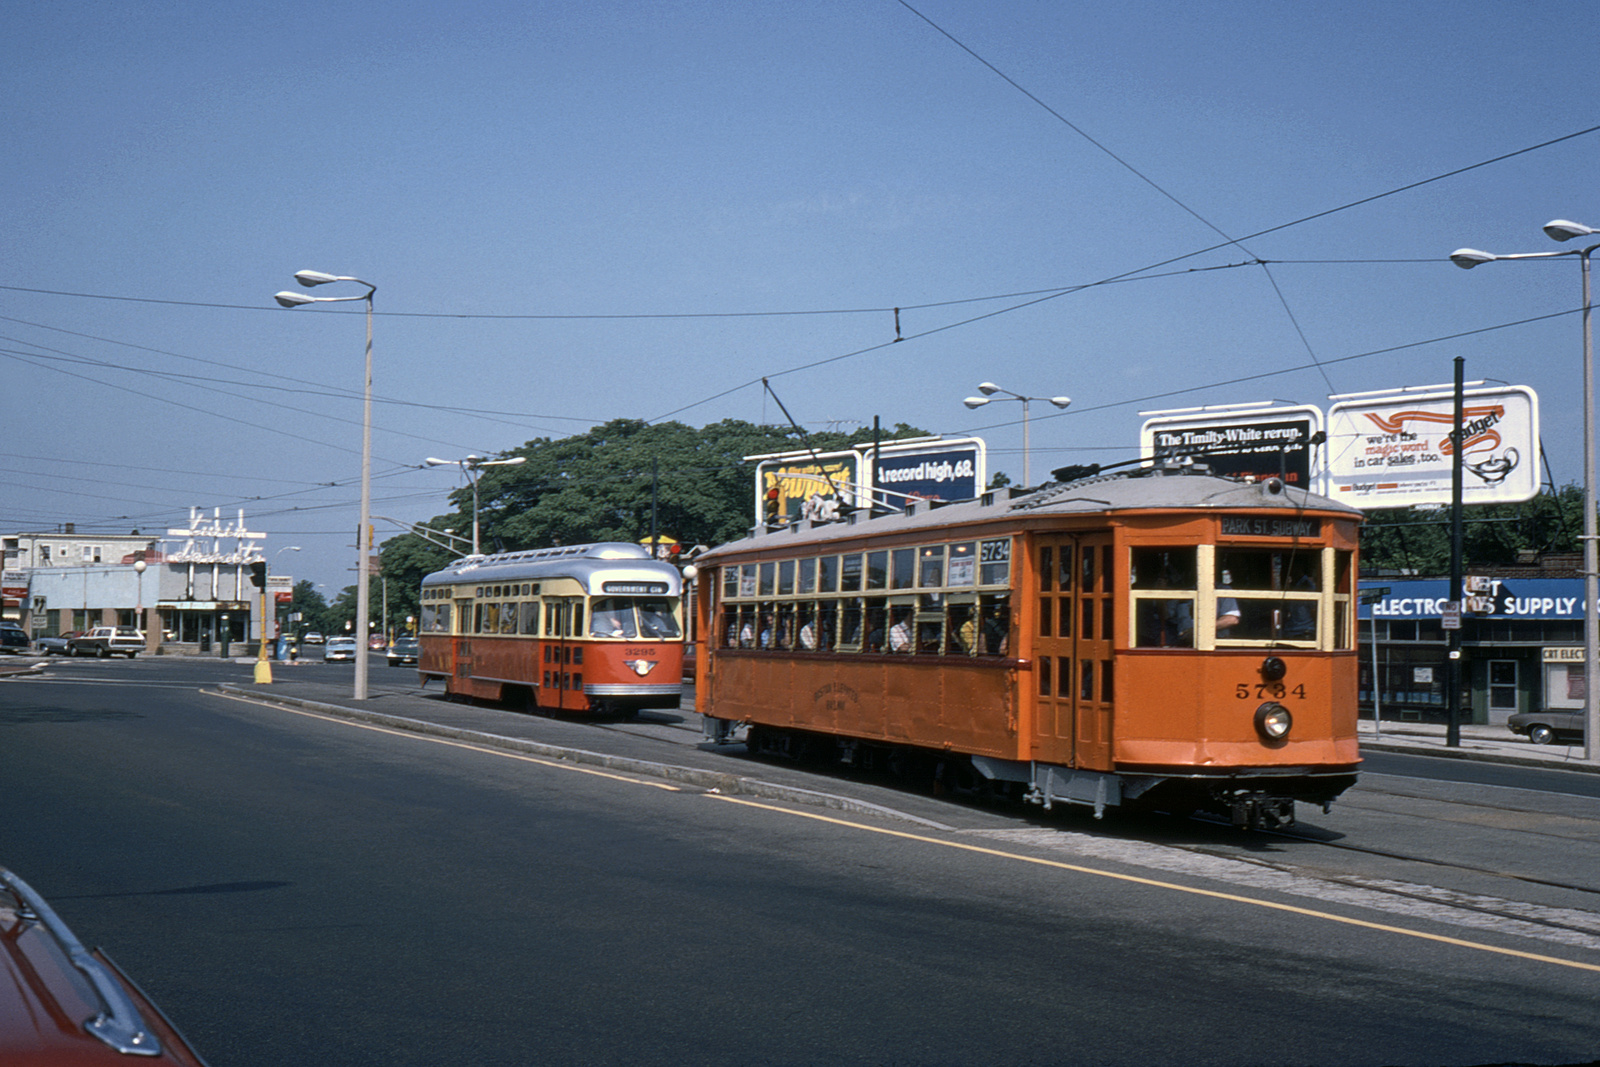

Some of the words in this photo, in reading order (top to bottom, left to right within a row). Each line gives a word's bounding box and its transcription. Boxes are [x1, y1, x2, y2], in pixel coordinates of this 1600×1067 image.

[1159, 433, 1182, 446] The
[1263, 427, 1303, 440] rerun.
[1366, 432, 1397, 444] we're
[1400, 431, 1417, 441] the
[1365, 444, 1399, 457] magic
[1400, 439, 1428, 452] word
[1354, 456, 1365, 468] in
[1366, 456, 1384, 466] car
[885, 462, 925, 482] record
[1221, 518, 1251, 534] PARK
[1254, 519, 1270, 534] ST.
[1271, 520, 1312, 536] SUBWAY
[981, 541, 1009, 561] 5734
[1373, 597, 1496, 615] ELECTROS
[1504, 597, 1577, 615] SUPPLY
[1446, 602, 1457, 611] NO
[625, 648, 656, 656] 3295
[1543, 649, 1558, 659] CRT
[1235, 682, 1307, 700] 5734
